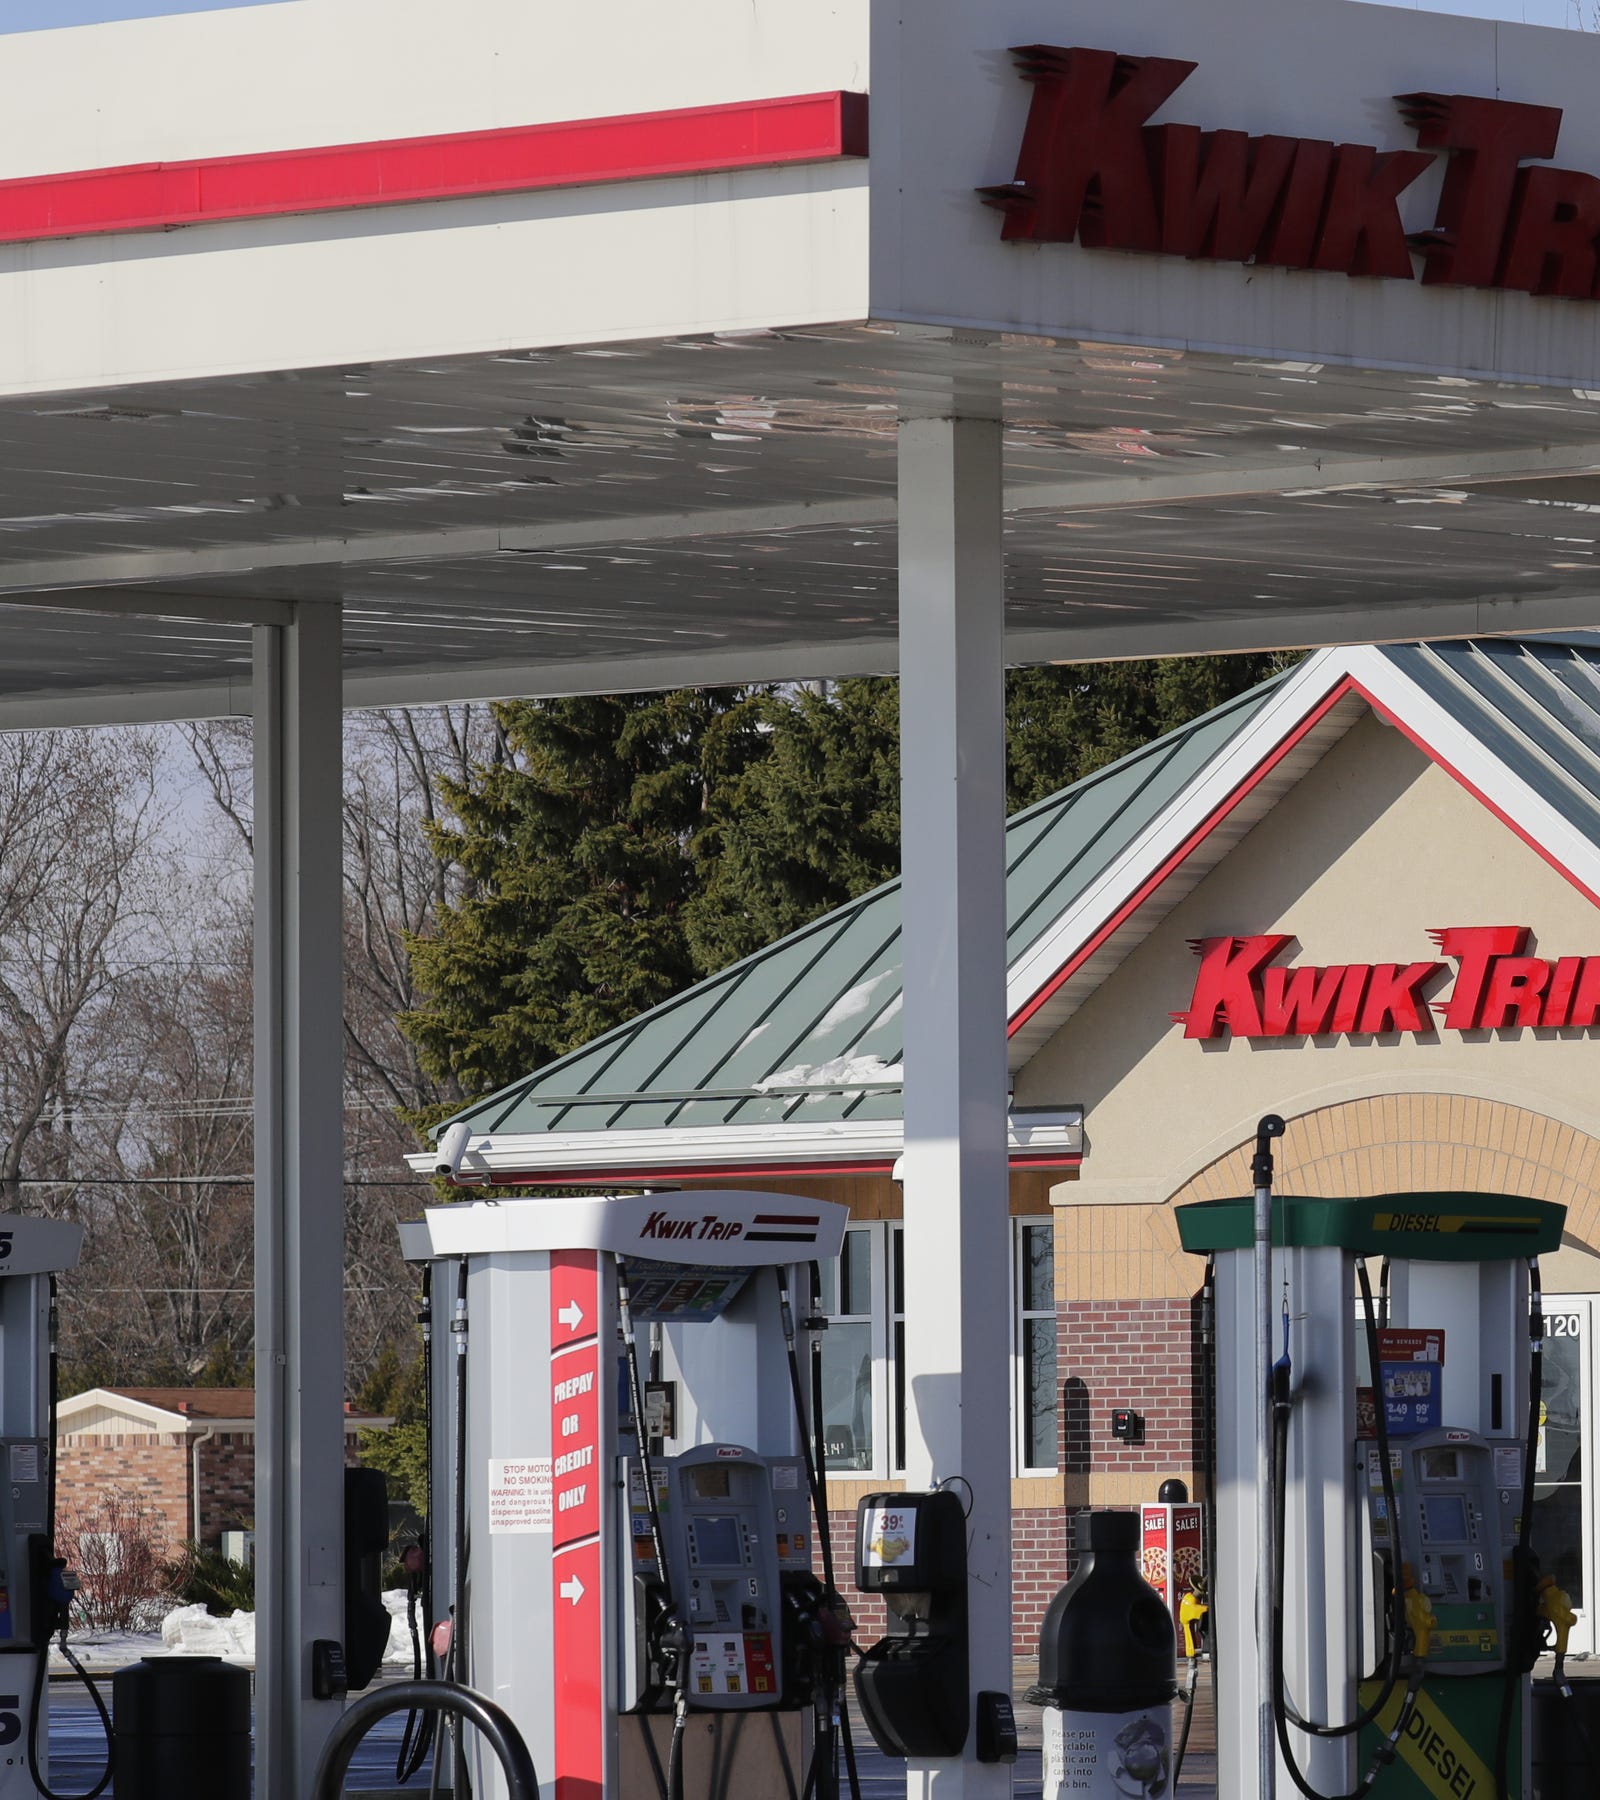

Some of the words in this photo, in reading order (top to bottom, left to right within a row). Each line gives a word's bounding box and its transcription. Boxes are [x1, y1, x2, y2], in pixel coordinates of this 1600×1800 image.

[975, 44, 1437, 279] KWIK
[1168, 934, 1452, 1039] KWIK
[1389, 1213, 1441, 1232] DIESEL
[1543, 1315, 1580, 1337] 120
[554, 1371, 594, 1405] PREPAY
[561, 1414, 579, 1437] OR
[554, 1445, 594, 1478] CREDIT
[504, 1465, 526, 1474] STOP
[527, 1464, 552, 1473] MOTO
[503, 1477, 517, 1485] NO
[491, 1498, 506, 1506] and
[509, 1498, 546, 1507] dangerous
[558, 1484, 587, 1512] ONLY
[491, 1508, 522, 1517] dispense
[524, 1508, 551, 1517] gasoline
[491, 1517, 532, 1527] unapproved
[1144, 1517, 1165, 1531] SALE!
[1175, 1517, 1198, 1531] SALE!
[1475, 1554, 1482, 1569] 3
[749, 1579, 758, 1595] 5
[1051, 1729, 1076, 1738] Please
[1079, 1729, 1095, 1741] put
[1051, 1742, 1095, 1754] recyclable
[1051, 1754, 1076, 1766] plastic
[1079, 1755, 1097, 1764] and
[1053, 1768, 1071, 1776] cans
[1073, 1766, 1093, 1776] into
[1055, 1780, 1070, 1789] this
[1072, 1780, 1091, 1789] bin.
